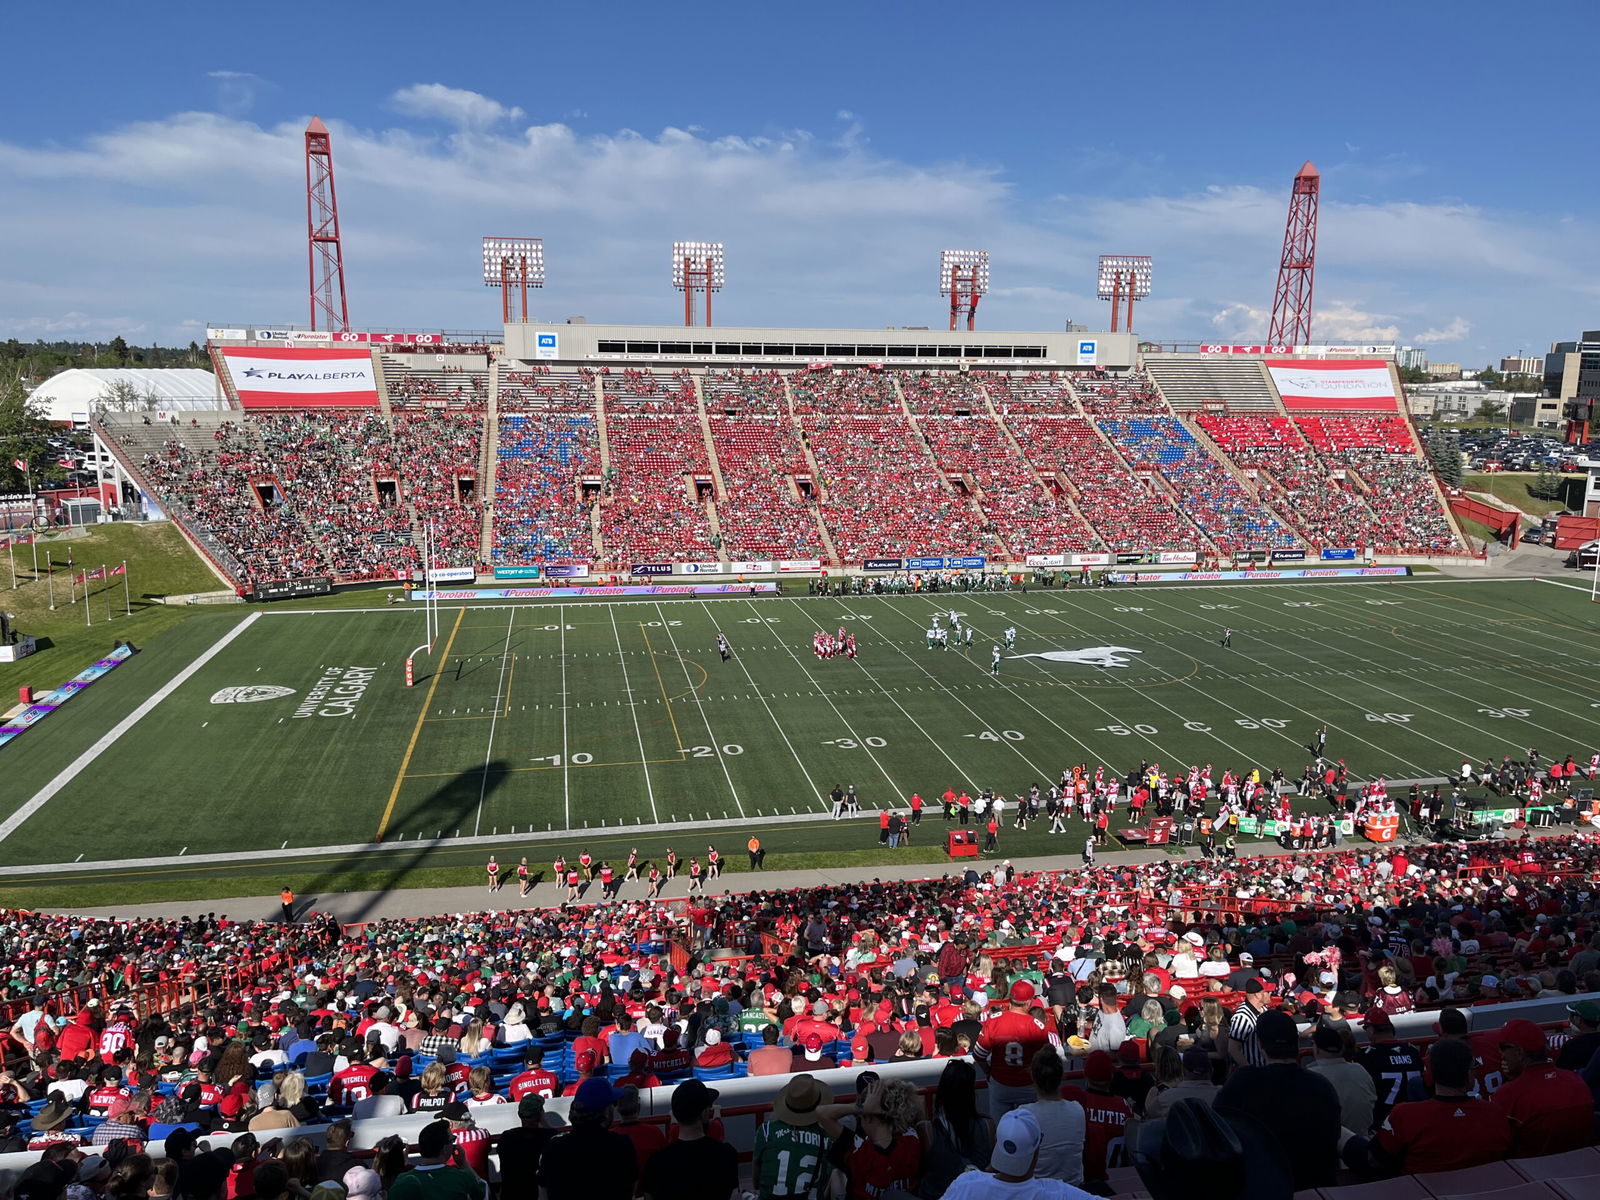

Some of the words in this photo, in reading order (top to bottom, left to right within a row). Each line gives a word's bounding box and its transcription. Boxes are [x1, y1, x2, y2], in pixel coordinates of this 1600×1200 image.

[341, 333, 359, 342] GO
[415, 334, 433, 343] GO
[1271, 346, 1287, 354] GO
[268, 371, 366, 381] PLAYALBERTA
[647, 565, 672, 573] TELUS
[1306, 569, 1340, 577] Purolator
[1126, 574, 1161, 582] Puolator
[1188, 572, 1222, 580] Purolator
[509, 589, 553, 597] Purolator
[584, 587, 626, 595] Purolator
[656, 585, 697, 593] Purolator
[292, 677, 338, 719] UNIVERSITY
[324, 666, 344, 676] OF
[318, 666, 378, 717] CALGARY
[1364, 712, 1411, 725] 40
[1477, 707, 1527, 719] 30
[1106, 724, 1158, 736] 50
[1183, 721, 1212, 733] C
[1234, 718, 1287, 730] 50
[978, 730, 1025, 742] 40
[833, 736, 888, 749] 30
[690, 744, 744, 757] 20
[543, 752, 594, 766] 10
[1382, 829, 1392, 839] G
[1293, 839, 1300, 847] G
[1033, 1018, 1045, 1030] 8
[1005, 1041, 1024, 1067] 8
[1389, 1055, 1413, 1065] EVANS
[653, 1056, 687, 1069] MITCHELL
[517, 1077, 551, 1091] SINGLETON
[93, 1095, 117, 1105] LEWIS
[419, 1097, 446, 1108] PHILPOT
[1087, 1107, 1126, 1126] LUTIE
[772, 1150, 819, 1200] 12
